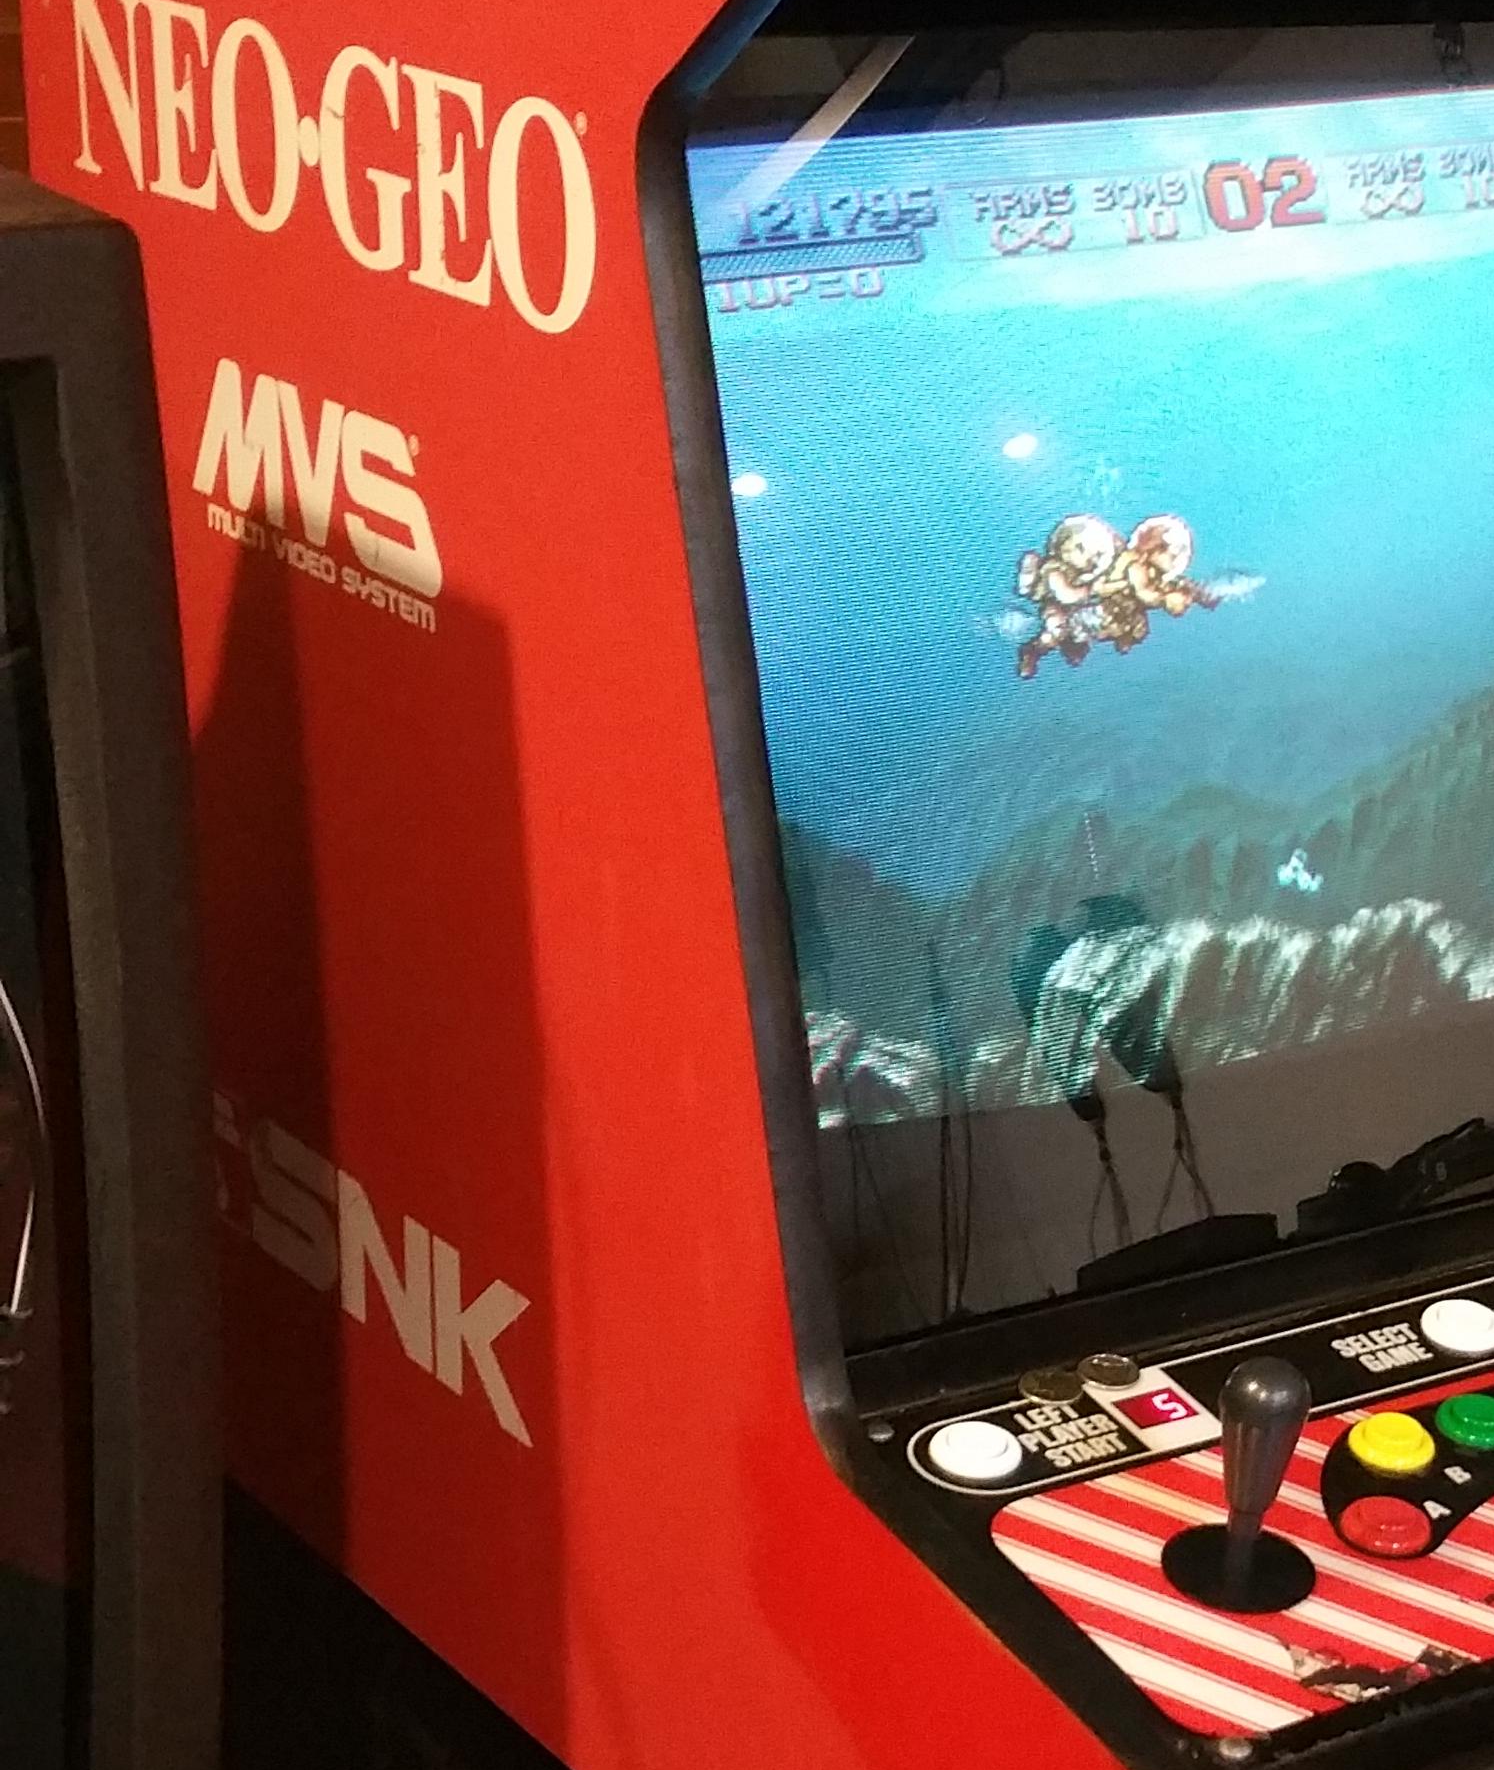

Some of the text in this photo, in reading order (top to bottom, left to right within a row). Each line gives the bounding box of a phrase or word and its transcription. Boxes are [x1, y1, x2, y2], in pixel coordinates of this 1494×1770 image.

[1204, 153, 1327, 233] 02
[1124, 205, 1181, 245] 10
[191, 357, 444, 599] MVS
[273, 531, 338, 585] VIDEO
[340, 565, 437, 635] SYSTEM
[249, 1117, 535, 1449] SNK
[1330, 1321, 1421, 1360] SELECT
[1358, 1340, 1435, 1375] GAME
[1013, 1400, 1082, 1432] LEFT
[1017, 1412, 1119, 1453] PLAYER
[1044, 1433, 1129, 1470] START
[1421, 1499, 1454, 1522] A
[1443, 1464, 1473, 1485] B
